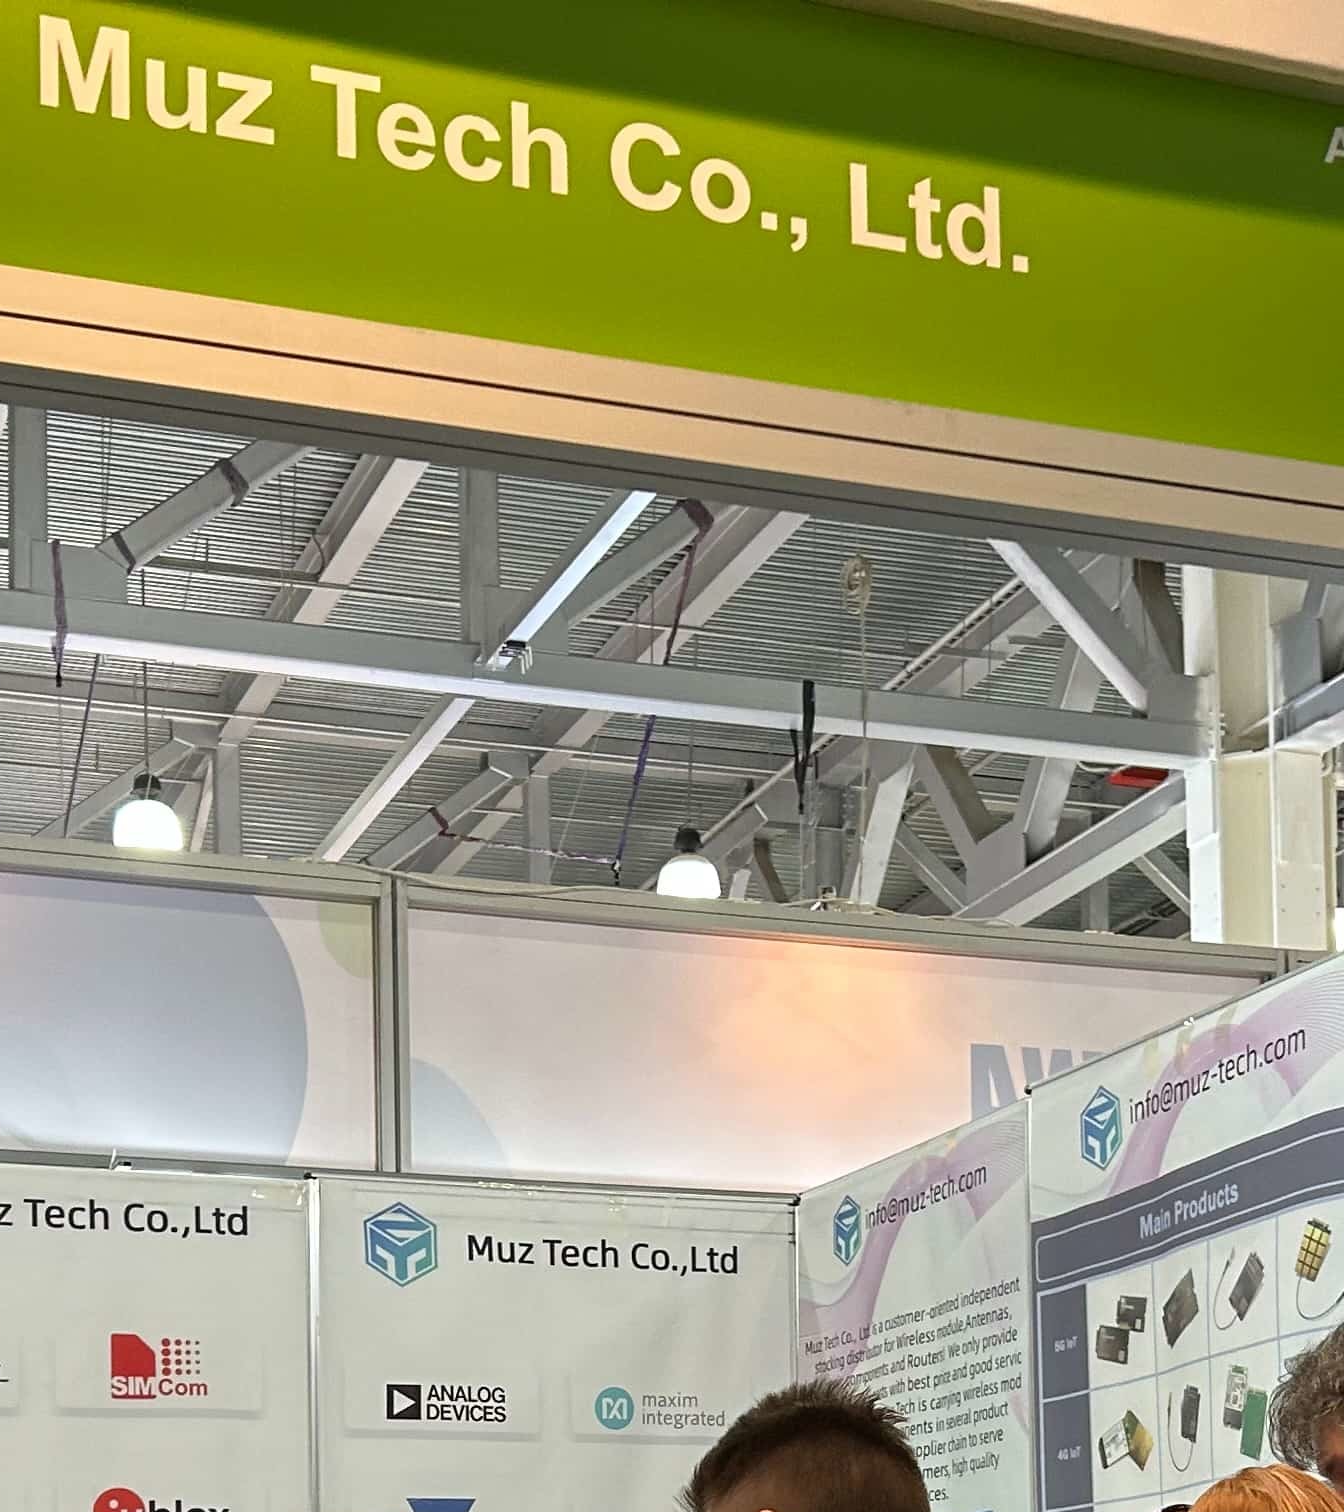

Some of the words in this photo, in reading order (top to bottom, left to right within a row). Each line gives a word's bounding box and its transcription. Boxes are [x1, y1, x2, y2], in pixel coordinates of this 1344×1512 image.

[37, 14, 275, 146] Muz
[310, 62, 571, 196] Tech
[610, 121, 808, 251] Co.,
[848, 162, 1032, 273] Ltd.
[1129, 1027, 1306, 1125] info@muz-tech.com
[865, 1164, 987, 1232] info@muz-tech.com
[1139, 1209, 1171, 1239] Main
[1174, 1184, 1239, 1224] Products
[24, 1198, 110, 1230] Tech
[123, 1203, 250, 1238] Co.,Ltd
[467, 1235, 534, 1265] Muz
[543, 1239, 619, 1269] Tech
[631, 1243, 739, 1276] Co.,Ltd
[806, 1339, 823, 1355] Muz
[961, 1277, 1020, 1309] independent
[816, 1356, 845, 1375] stocking
[884, 1340, 895, 1355] for
[896, 1328, 935, 1351] Wireless
[890, 1355, 905, 1373] and
[962, 1337, 981, 1355] only
[982, 1326, 1018, 1349] provide
[427, 1385, 506, 1402] ANALOG
[907, 1376, 930, 1391] best
[951, 1366, 967, 1382] and
[969, 1361, 993, 1380] good
[963, 1381, 998, 1400] wireless
[1001, 1373, 1022, 1392] mod
[426, 1405, 506, 1423] DEVICES
[642, 1393, 698, 1408] maxim
[936, 1417, 944, 1431] in
[973, 1403, 1008, 1426] product
[642, 1411, 726, 1429] integrated
[968, 1432, 977, 1446] to
[979, 1428, 1003, 1445] serve
[969, 1453, 999, 1474] quality
